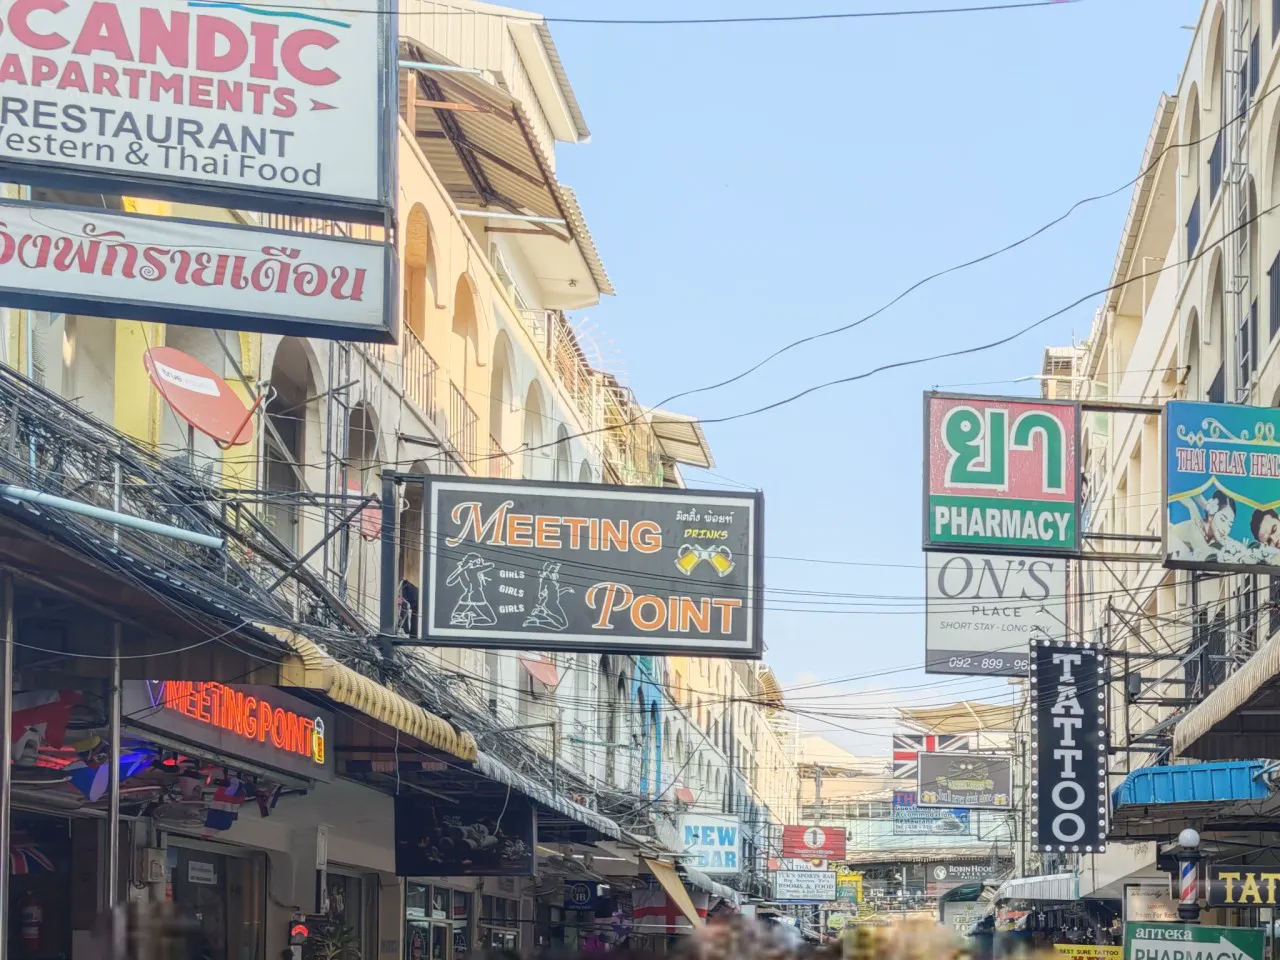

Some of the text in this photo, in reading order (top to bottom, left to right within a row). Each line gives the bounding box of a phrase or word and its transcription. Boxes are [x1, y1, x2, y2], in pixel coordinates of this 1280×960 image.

[0, 0, 342, 87] CANDIC
[0, 52, 298, 119] APARTMENTS
[1, 96, 295, 158] RESTAURANT
[0, 125, 322, 187] estern & Thai Food
[0, 221, 367, 303] องพักรายเดือน
[940, 405, 1068, 495] ยา
[1176, 447, 1206, 474] THAI
[1209, 449, 1248, 476] RELAX
[445, 500, 663, 554] MEETING
[684, 528, 728, 540] DRINKS
[934, 505, 1071, 542] PHARMACY
[499, 570, 525, 579] GIRLS
[499, 584, 525, 597] GIRLS
[499, 604, 525, 613] GIRLS
[585, 582, 743, 635] POINT
[971, 605, 1022, 618] PLACE
[940, 621, 971, 630] SHORT
[973, 622, 995, 631] STAY
[1001, 624, 1027, 632] LONG
[949, 656, 971, 668] 092
[982, 658, 1003, 669] 899
[1014, 659, 1029, 670] 96
[165, 680, 314, 757] MEETING POINT
[1051, 653, 1086, 842] TATTOO
[685, 825, 738, 846] NEW
[697, 850, 737, 868] BAR
[1135, 927, 1193, 941] аптека
